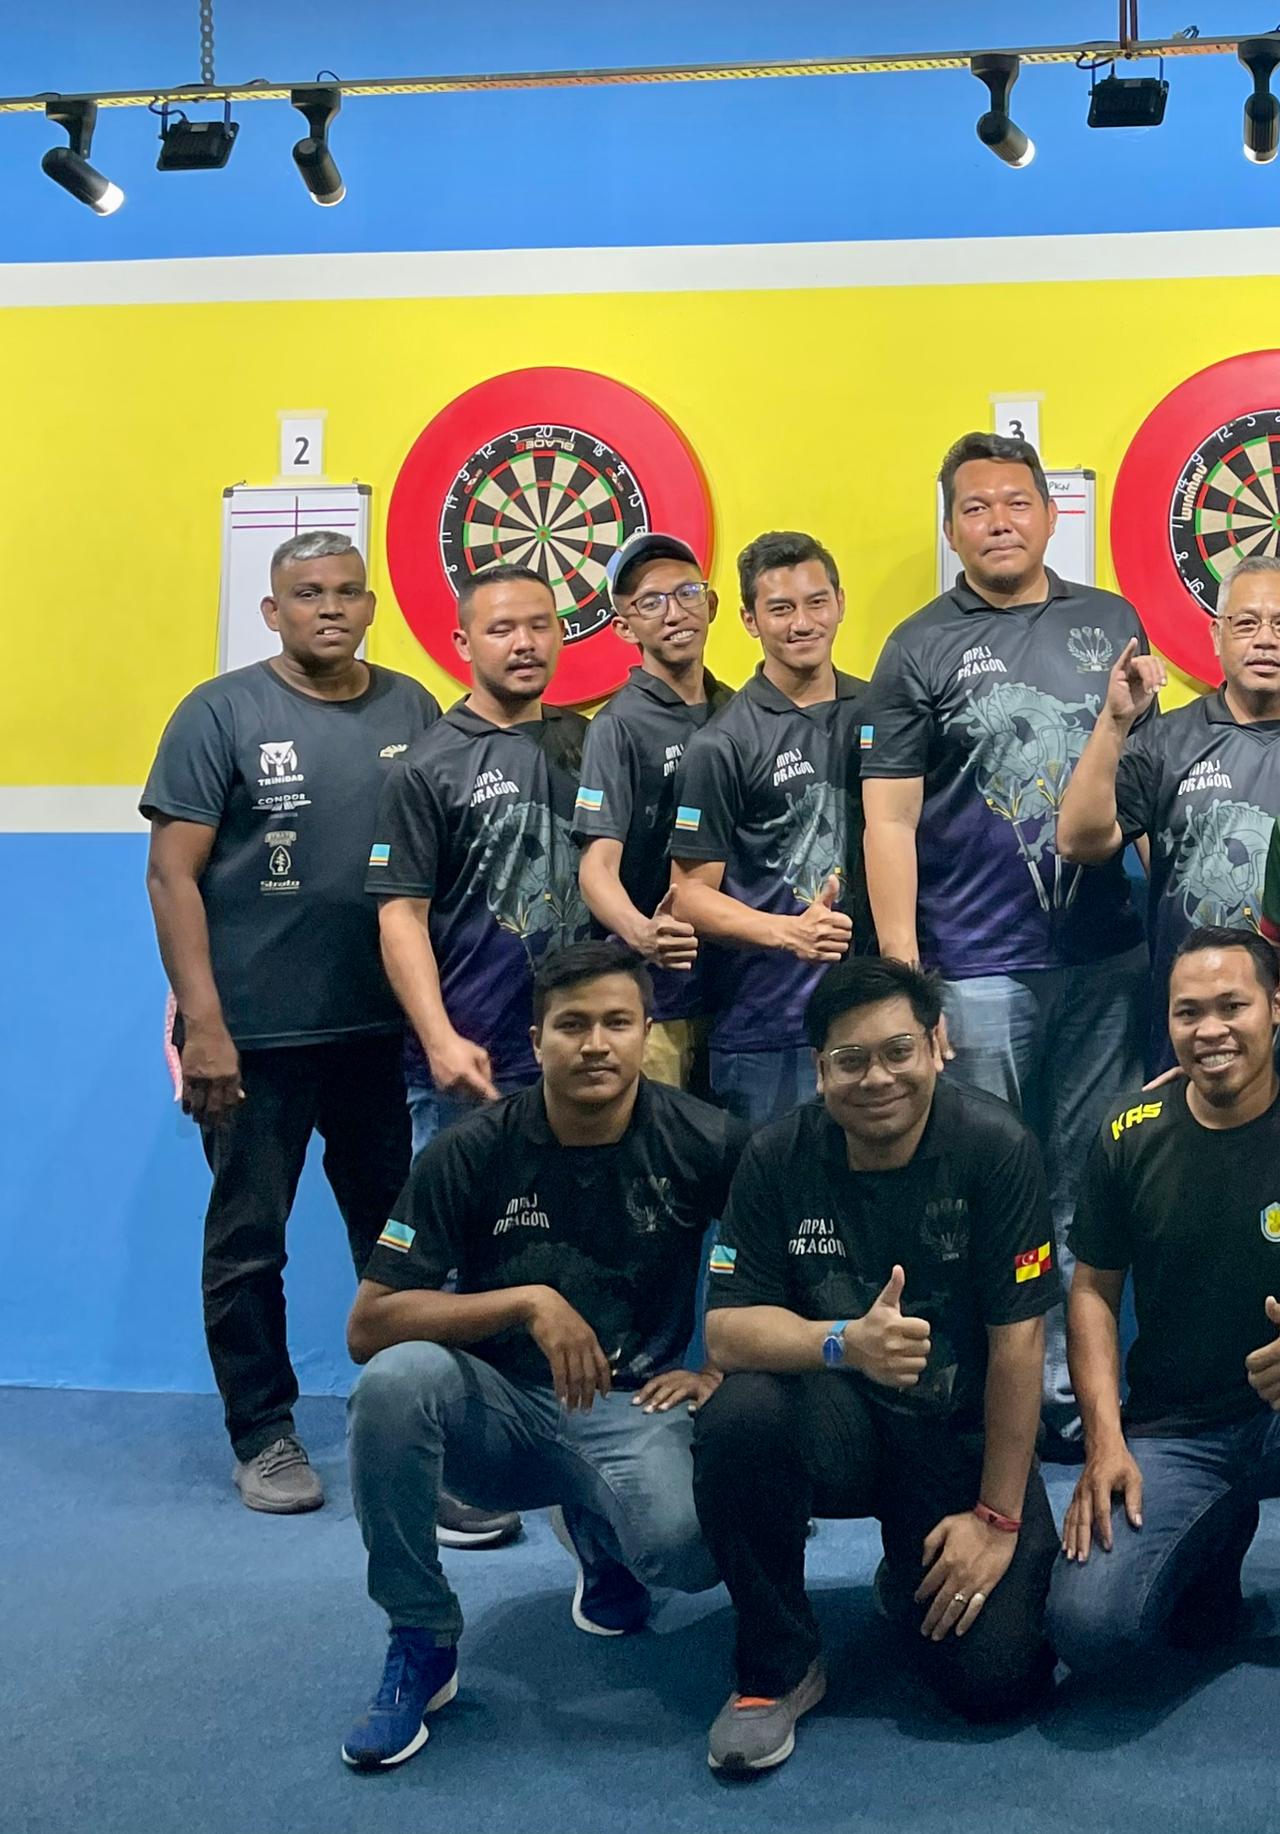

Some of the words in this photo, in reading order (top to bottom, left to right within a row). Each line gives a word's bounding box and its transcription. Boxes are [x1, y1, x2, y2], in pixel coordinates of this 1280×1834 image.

[1008, 420, 1025, 441] 3
[293, 436, 310, 465] 2
[963, 645, 992, 664] MPAJ
[776, 748, 803, 768] MPAJ
[1189, 760, 1221, 776] MPAJ
[773, 761, 815, 787] DRAGON
[1177, 774, 1232, 795] DRAGON
[257, 793, 306, 805] CONDOR
[1110, 1100, 1163, 1141] KAS
[799, 1218, 834, 1235] MPAJ
[788, 1237, 847, 1259] DRAGON
